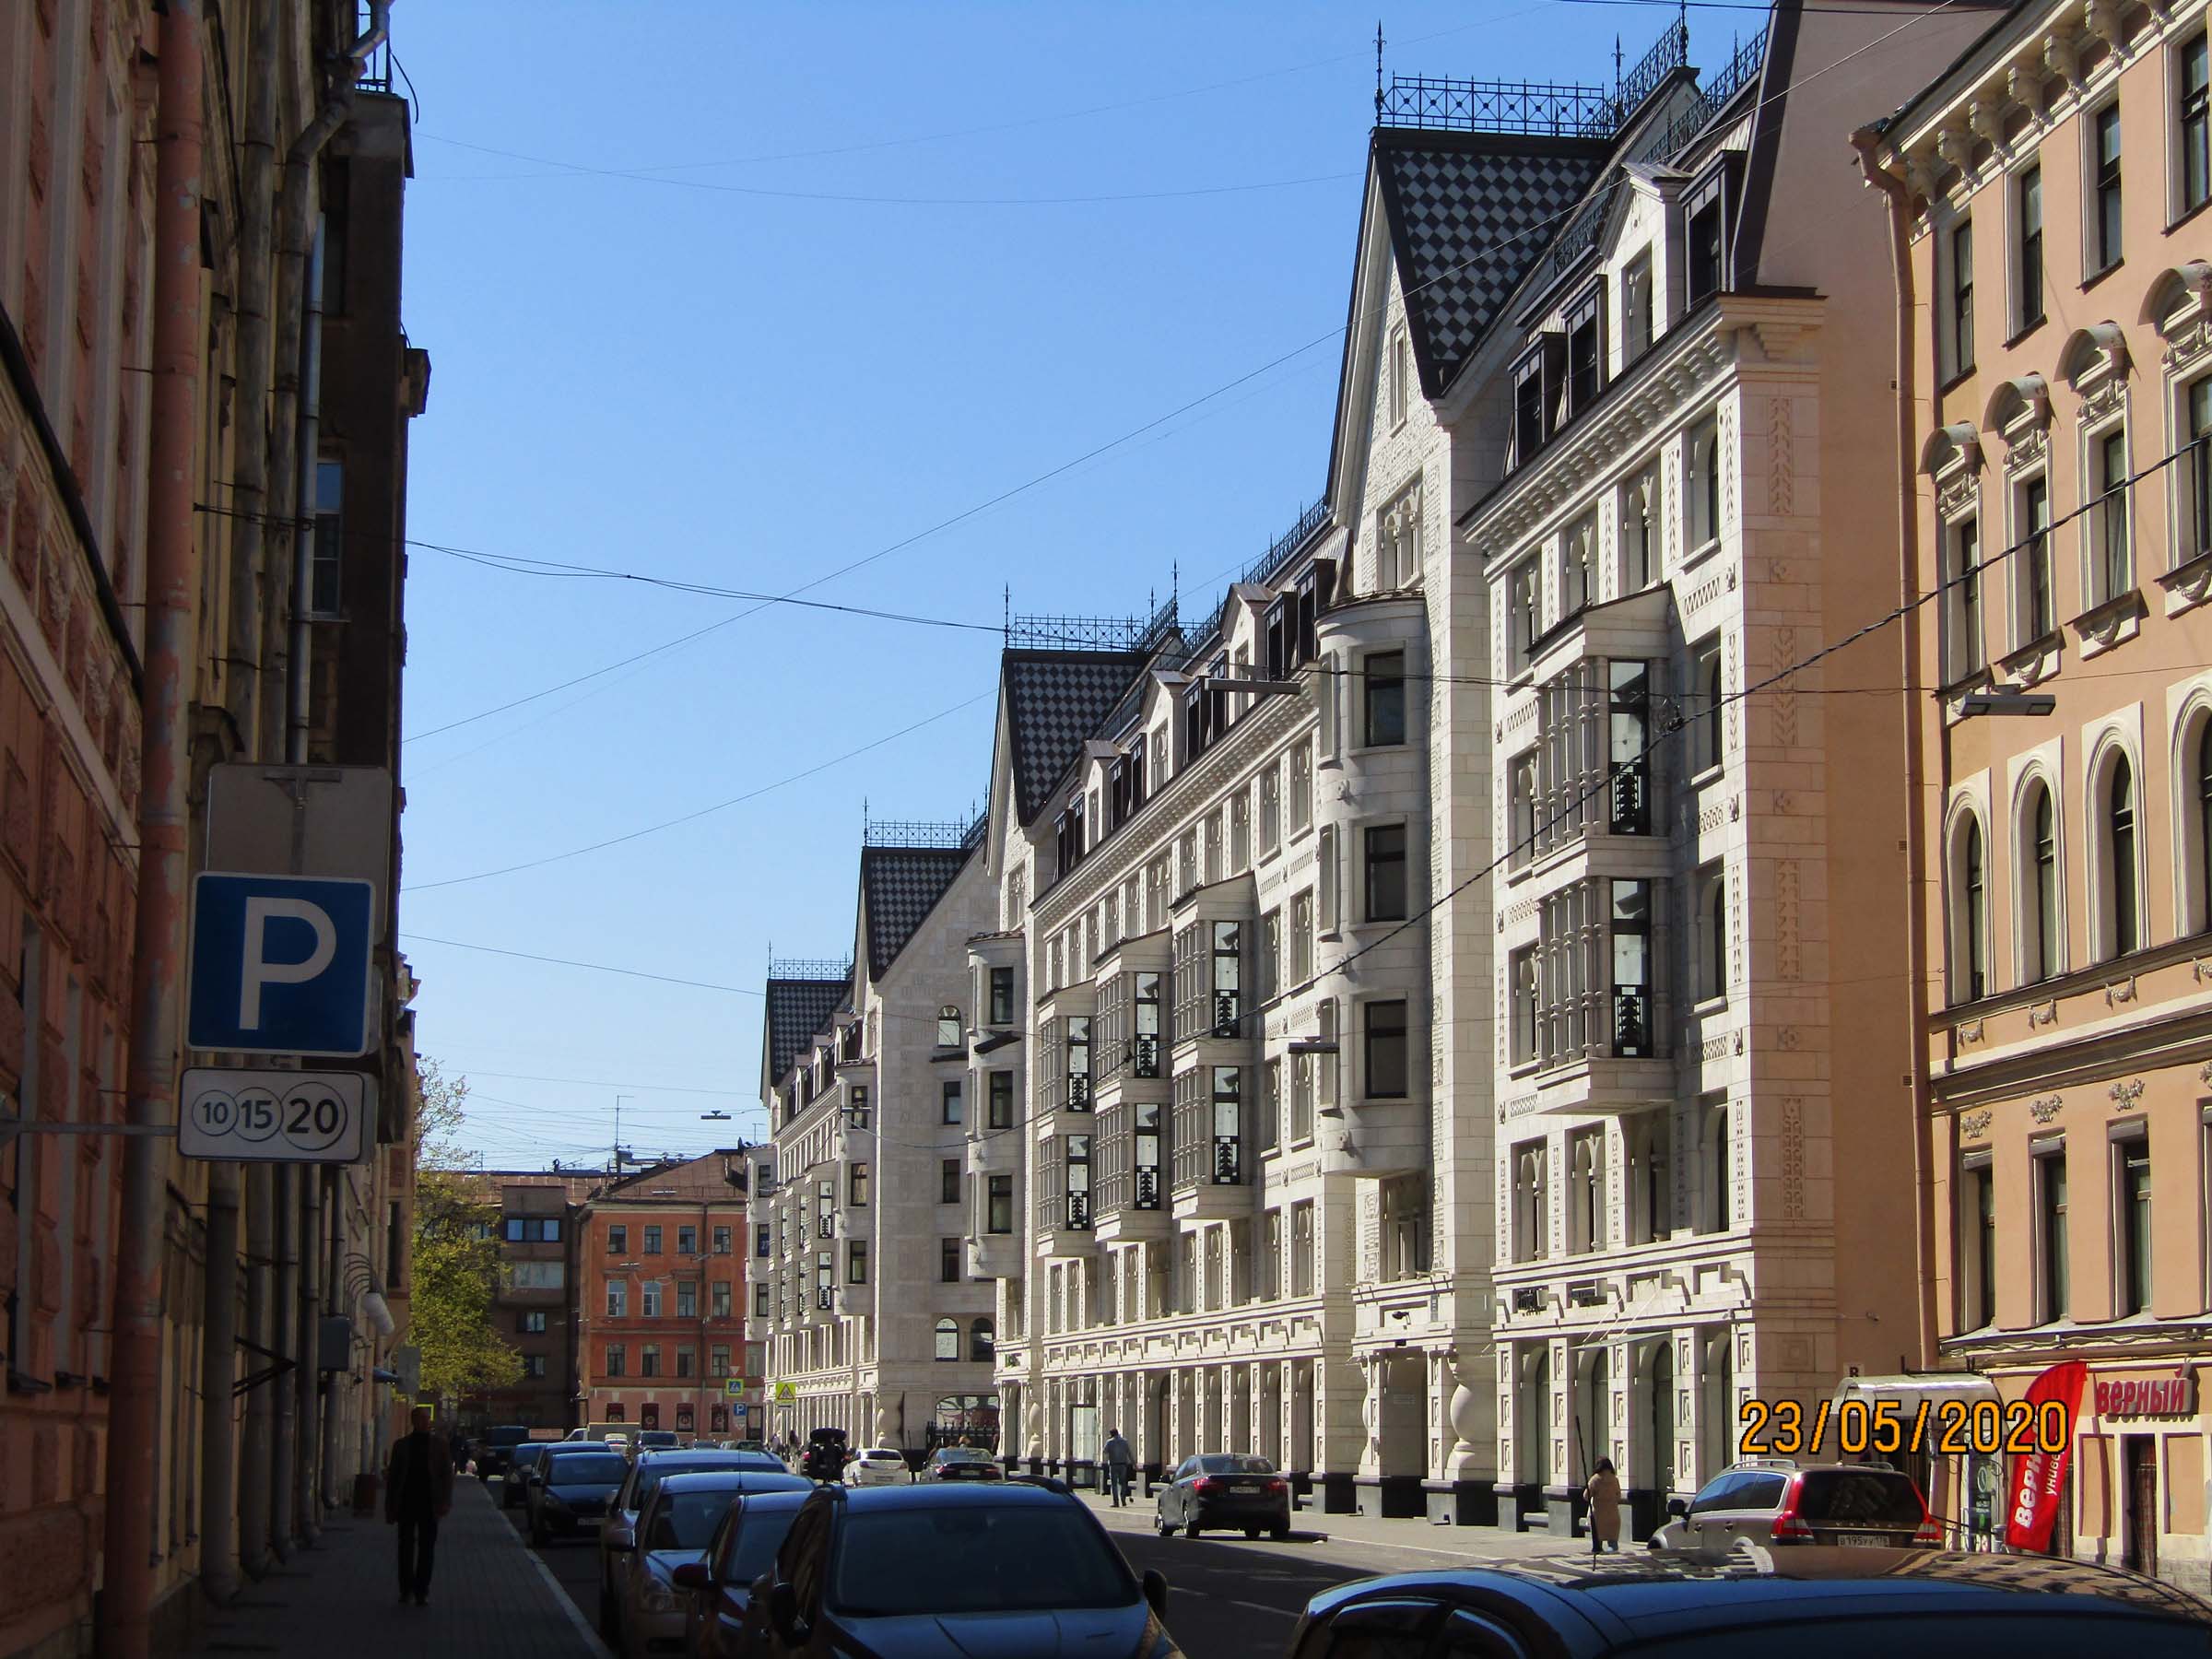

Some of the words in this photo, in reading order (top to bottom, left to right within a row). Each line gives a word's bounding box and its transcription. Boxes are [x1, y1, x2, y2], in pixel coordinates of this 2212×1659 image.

[239, 897, 337, 1030] P
[203, 1101, 229, 1125] 10
[241, 1100, 273, 1129] 15
[288, 1099, 339, 1135] 20
[736, 1404, 745, 1415] P
[2015, 1406, 2044, 1529] Верн
